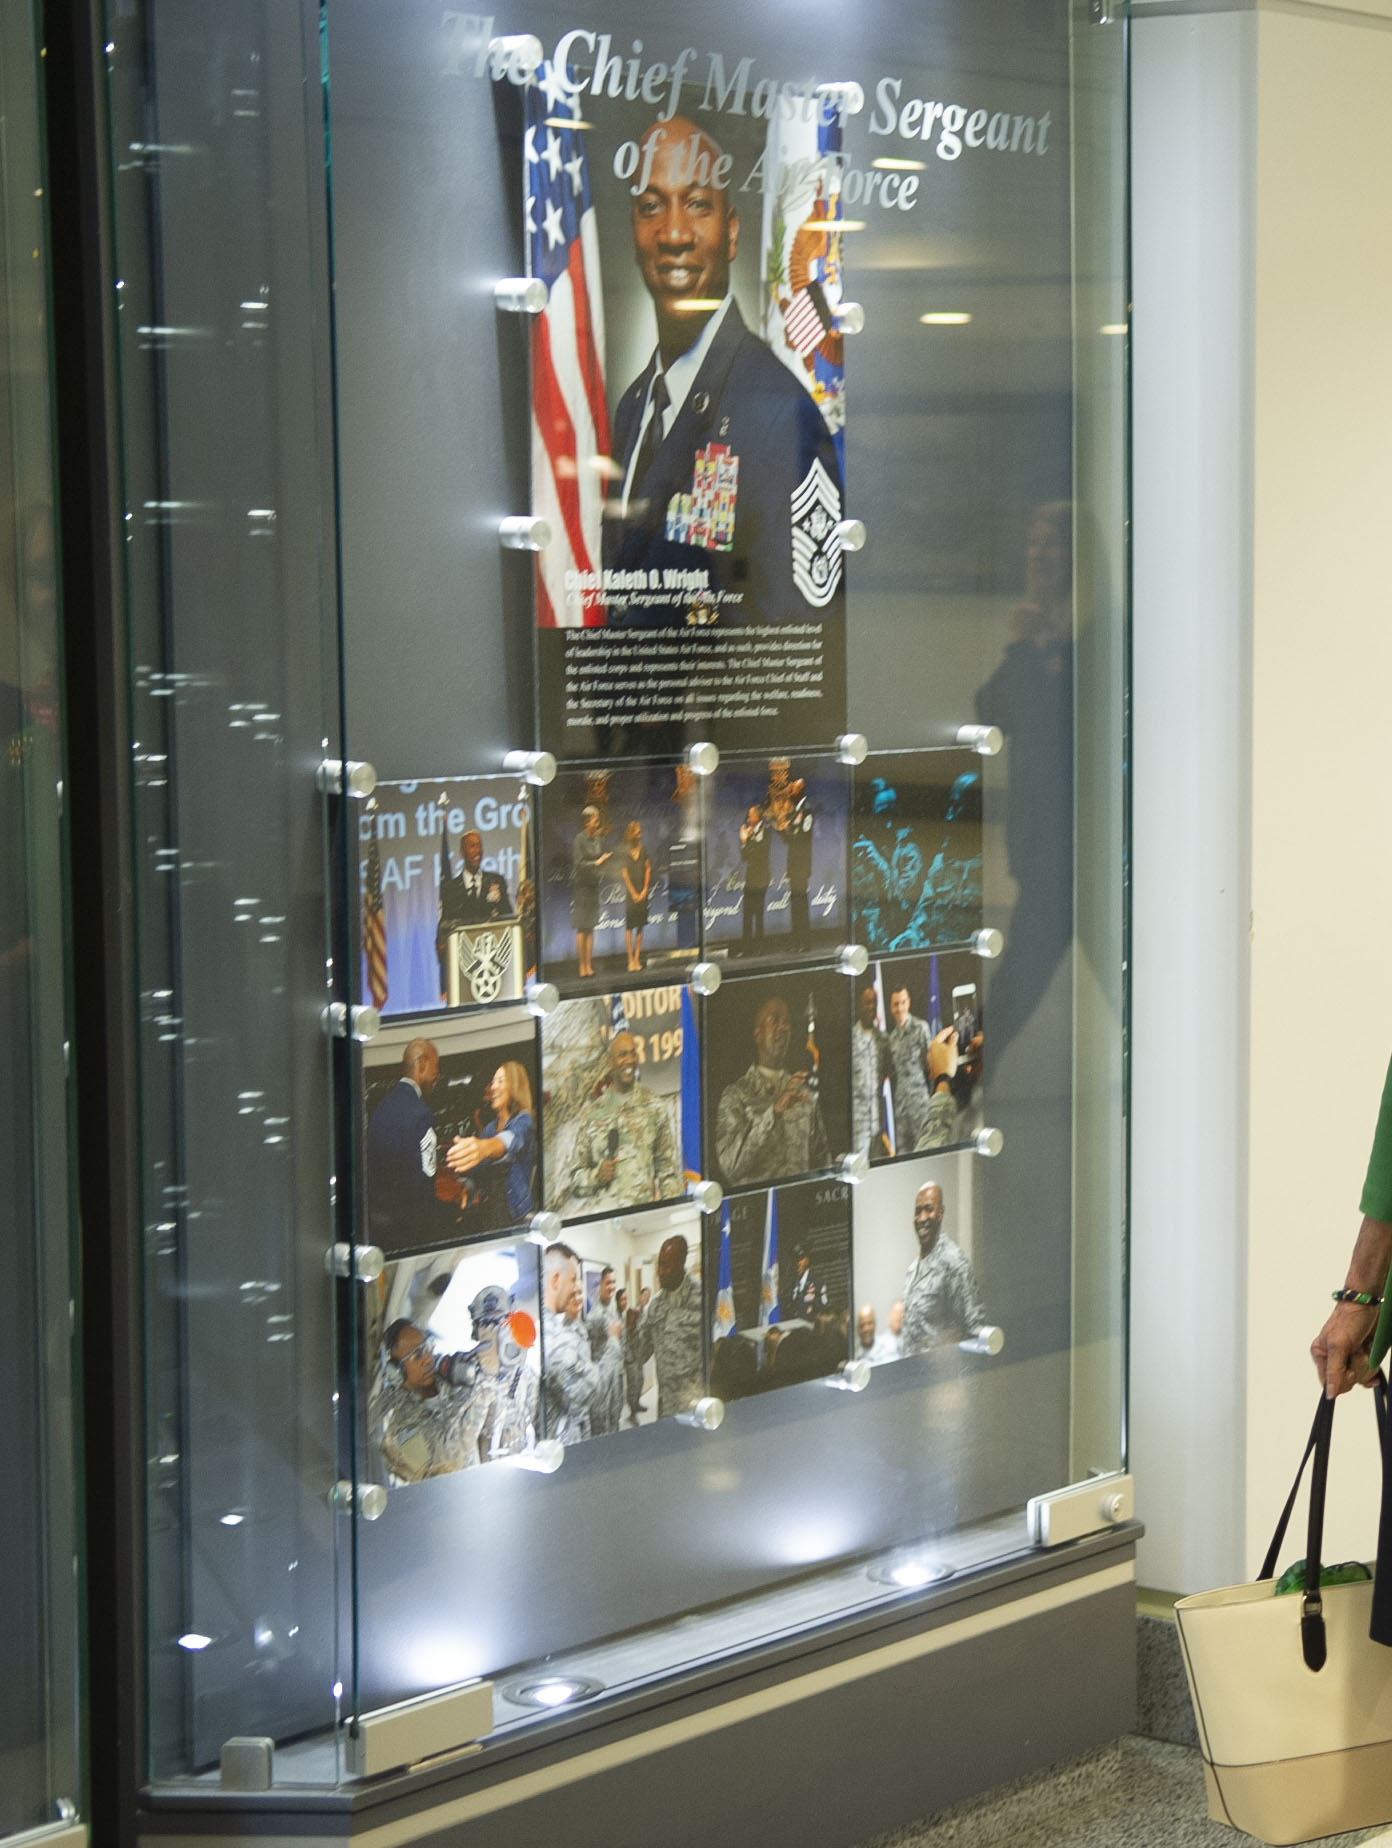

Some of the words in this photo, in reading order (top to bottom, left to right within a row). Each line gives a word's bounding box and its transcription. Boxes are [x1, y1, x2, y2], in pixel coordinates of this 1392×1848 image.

[440, 10, 535, 86] The
[552, 29, 697, 122] Chief
[697, 52, 857, 128] Master
[868, 76, 1053, 161] Sergeant
[613, 128, 664, 197] of
[668, 135, 732, 191] the
[820, 150, 919, 211] Force
[663, 568, 710, 591] Wright
[415, 801, 467, 837] the
[474, 796, 531, 831] Gro
